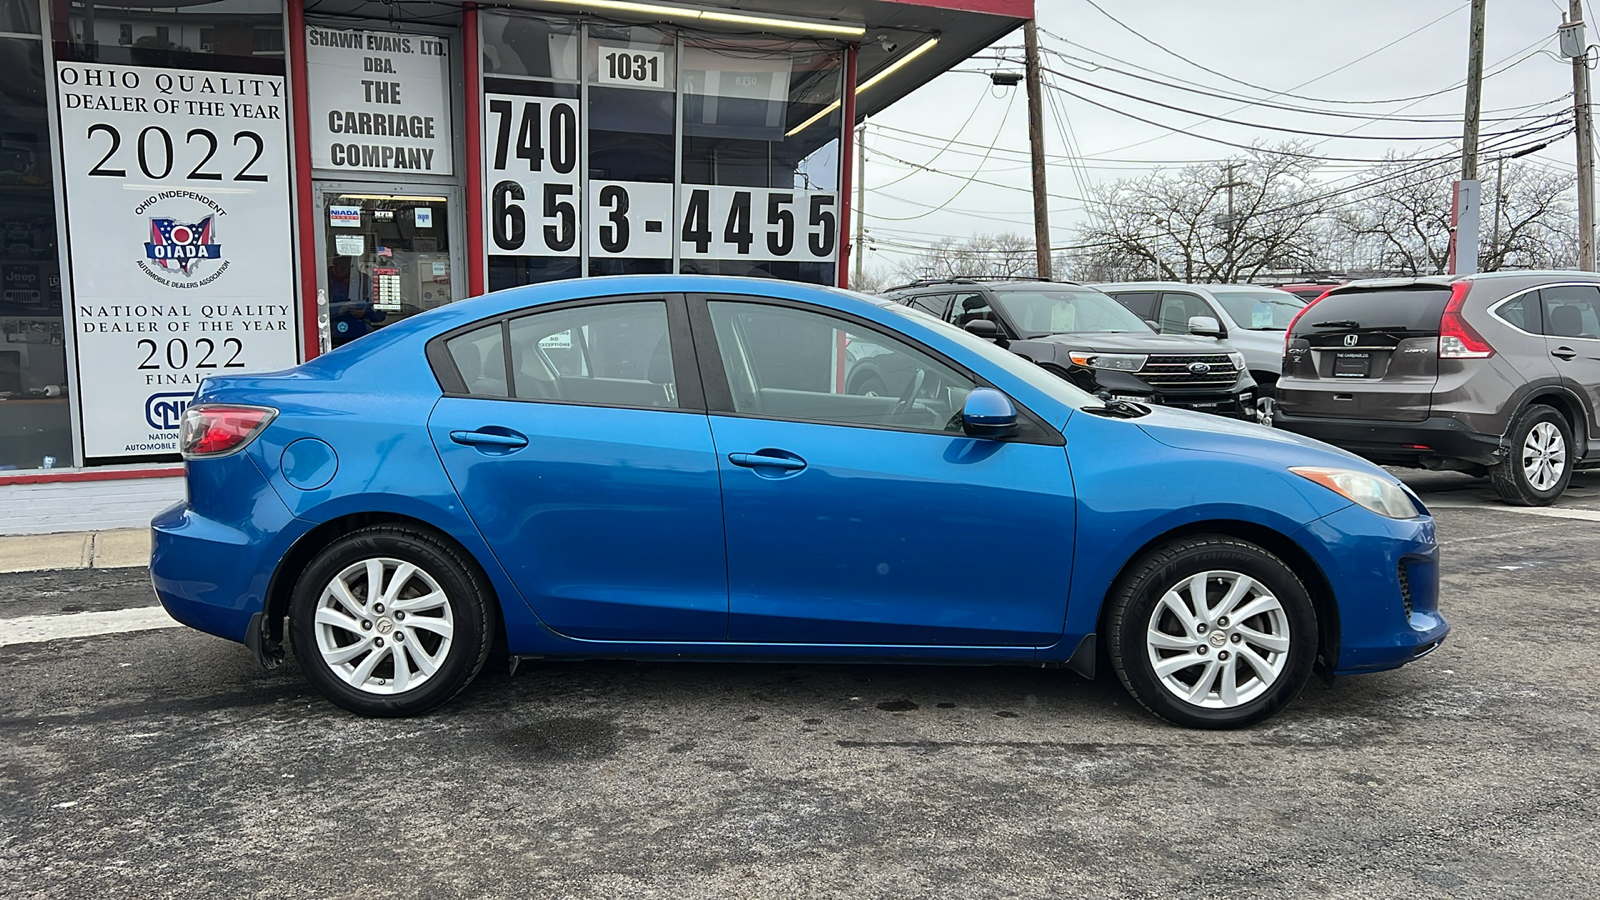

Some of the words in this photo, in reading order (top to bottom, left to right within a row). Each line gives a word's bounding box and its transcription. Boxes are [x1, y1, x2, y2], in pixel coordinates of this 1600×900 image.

[309, 30, 363, 50] SHAWN
[420, 40, 447, 57] LTD.
[363, 57, 397, 74] DBA.
[605, 53, 659, 82] 1031
[60, 67, 140, 89] OHIO
[155, 74, 283, 98] QUALITY
[361, 80, 401, 105] THE
[65, 93, 149, 113] DEALER
[153, 98, 180, 114] OF
[185, 101, 225, 117] THE
[230, 103, 281, 120] YEAR
[328, 110, 435, 139] CARRIAGE
[489, 99, 577, 175] 740
[87, 123, 269, 183] 2022
[330, 142, 434, 171] COMPANY
[135, 196, 158, 215] OHIO
[158, 190, 227, 217] INDEPENDENT
[154, 245, 209, 258] OIADA
[6, 272, 36, 283] Jeep
[136, 260, 170, 287] AUTOMOBILE
[171, 281, 199, 289] DEALERS
[199, 260, 230, 287] ASSOCIATION
[80, 305, 192, 318] NATIONAL
[201, 305, 290, 318] QUALITY
[83, 322, 159, 333] DEALER
[167, 322, 190, 333] OF
[199, 321, 235, 332] THE
[242, 320, 288, 331] YEAR
[137, 337, 246, 370] 2022
[146, 374, 205, 385] FINAL
[125, 443, 177, 451] AUTOMOBILE
[148, 433, 179, 441] NATION
